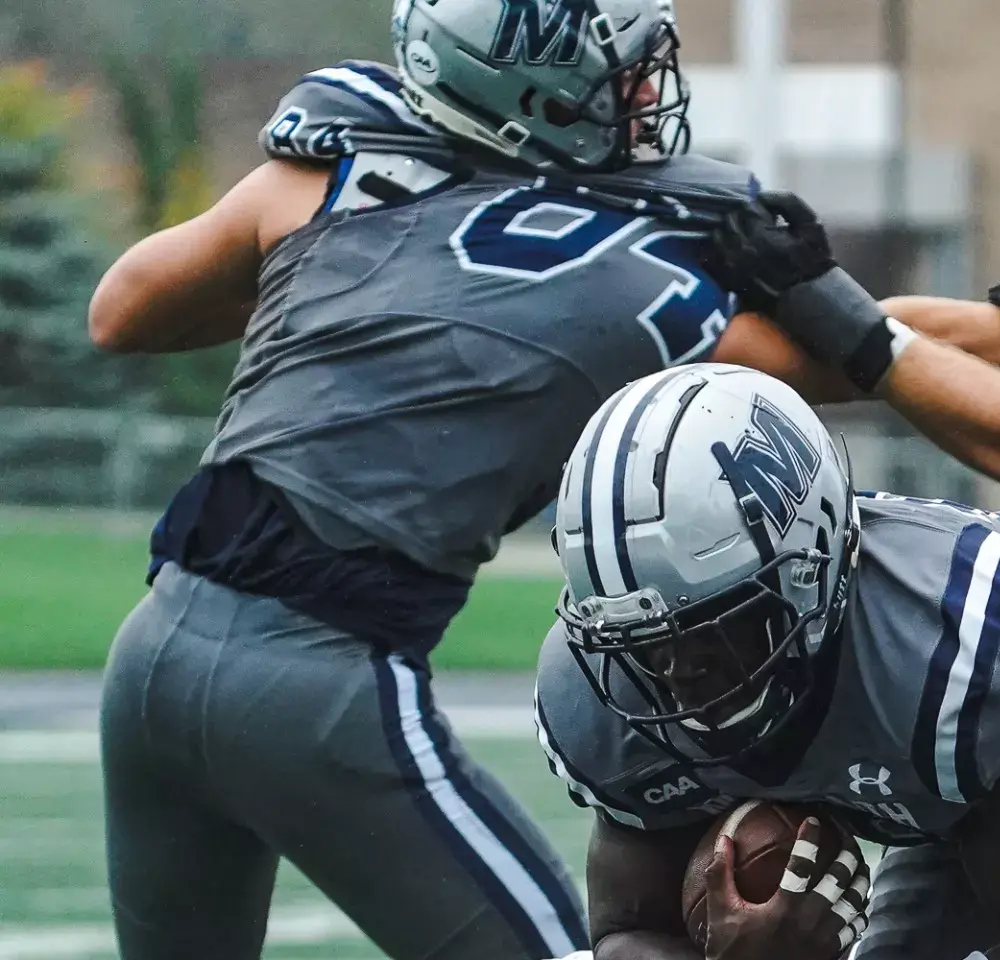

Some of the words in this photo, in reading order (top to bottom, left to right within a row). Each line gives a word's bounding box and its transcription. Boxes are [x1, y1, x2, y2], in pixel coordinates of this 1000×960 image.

[488, 0, 589, 67] M
[718, 391, 822, 541] M
[643, 775, 700, 804] CAA
